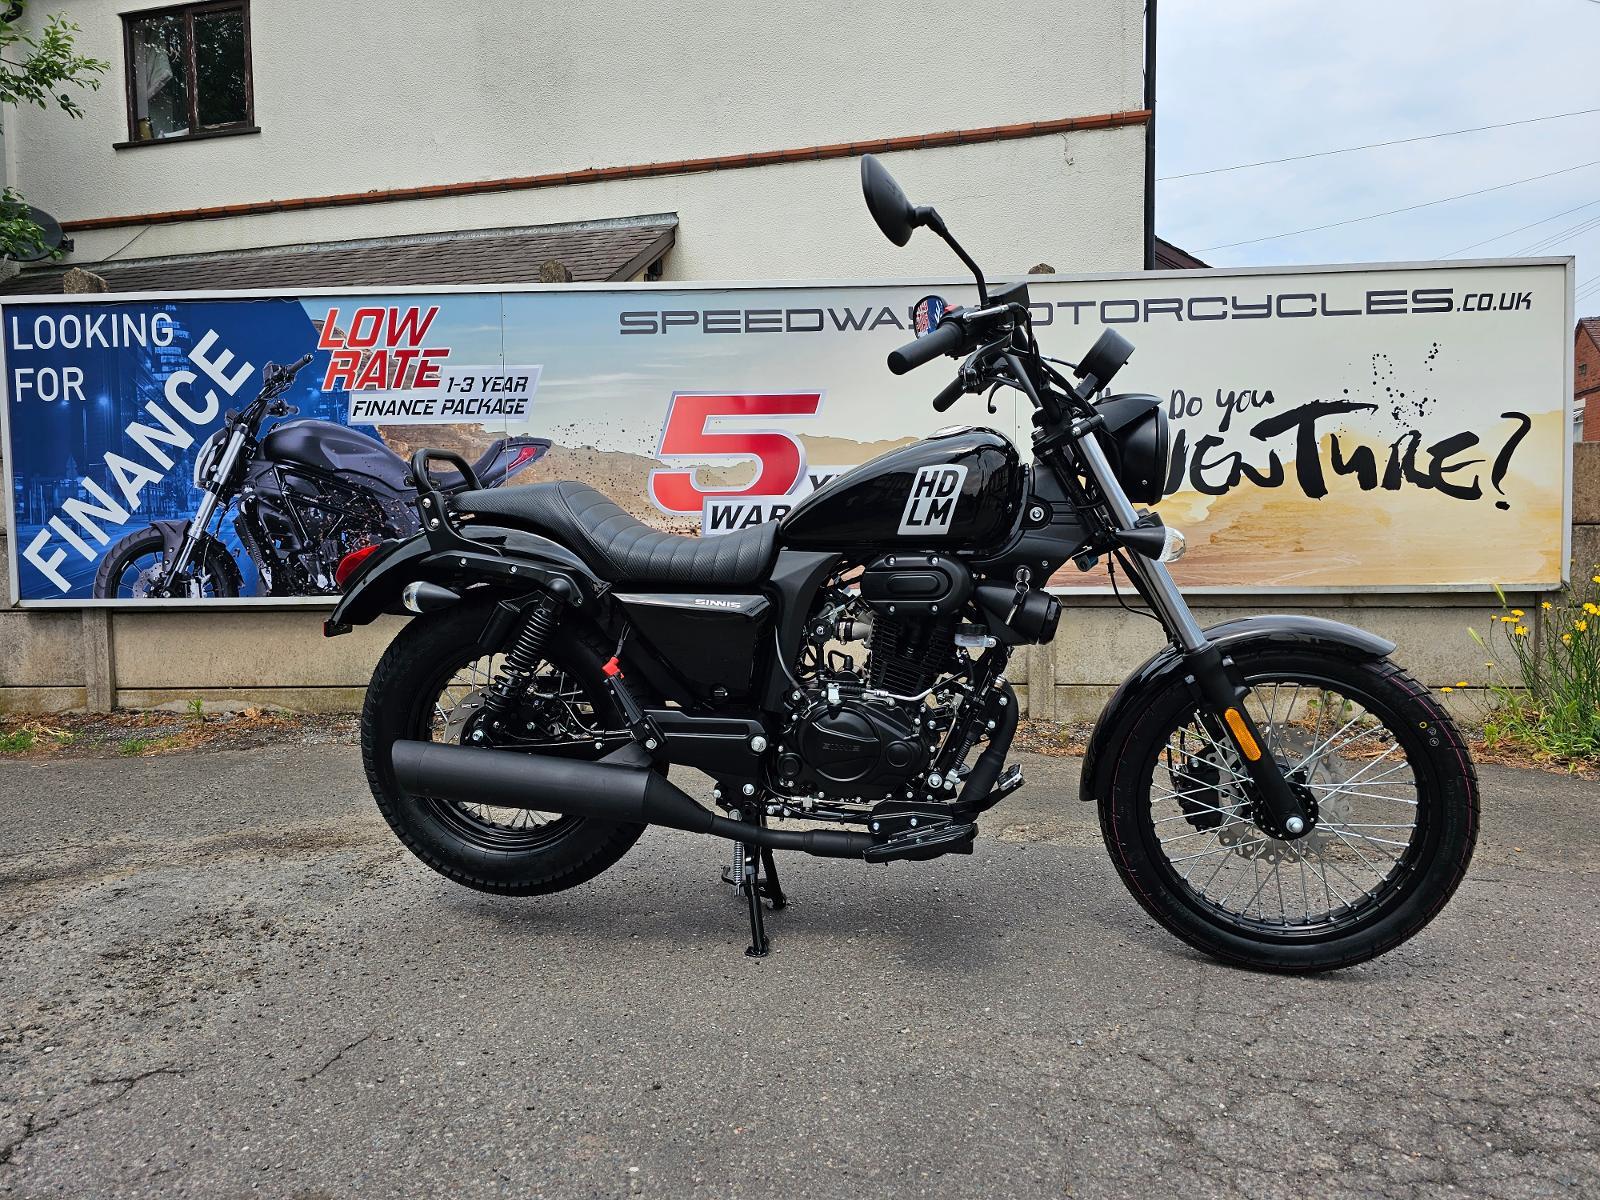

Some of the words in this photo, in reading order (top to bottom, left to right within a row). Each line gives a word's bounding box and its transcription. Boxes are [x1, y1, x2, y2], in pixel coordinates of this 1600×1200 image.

[12, 312, 174, 350] LOOKING
[318, 306, 439, 349] LOW
[620, 306, 914, 335] SPEEDWA
[14, 366, 86, 403] FOR
[322, 348, 451, 390] RATE
[446, 377, 476, 393] 1-3
[480, 376, 530, 393] YEAR
[352, 399, 437, 416] FINANCE
[440, 398, 529, 415] PACKAGE
[1168, 389, 1203, 420] Do
[1215, 388, 1275, 433] you
[22, 328, 255, 593] FINANCE
[652, 393, 823, 514] 5
[914, 469, 960, 498] HD
[710, 505, 792, 529] WAR
[905, 498, 954, 526] LM
[695, 598, 741, 609] SINNIS
